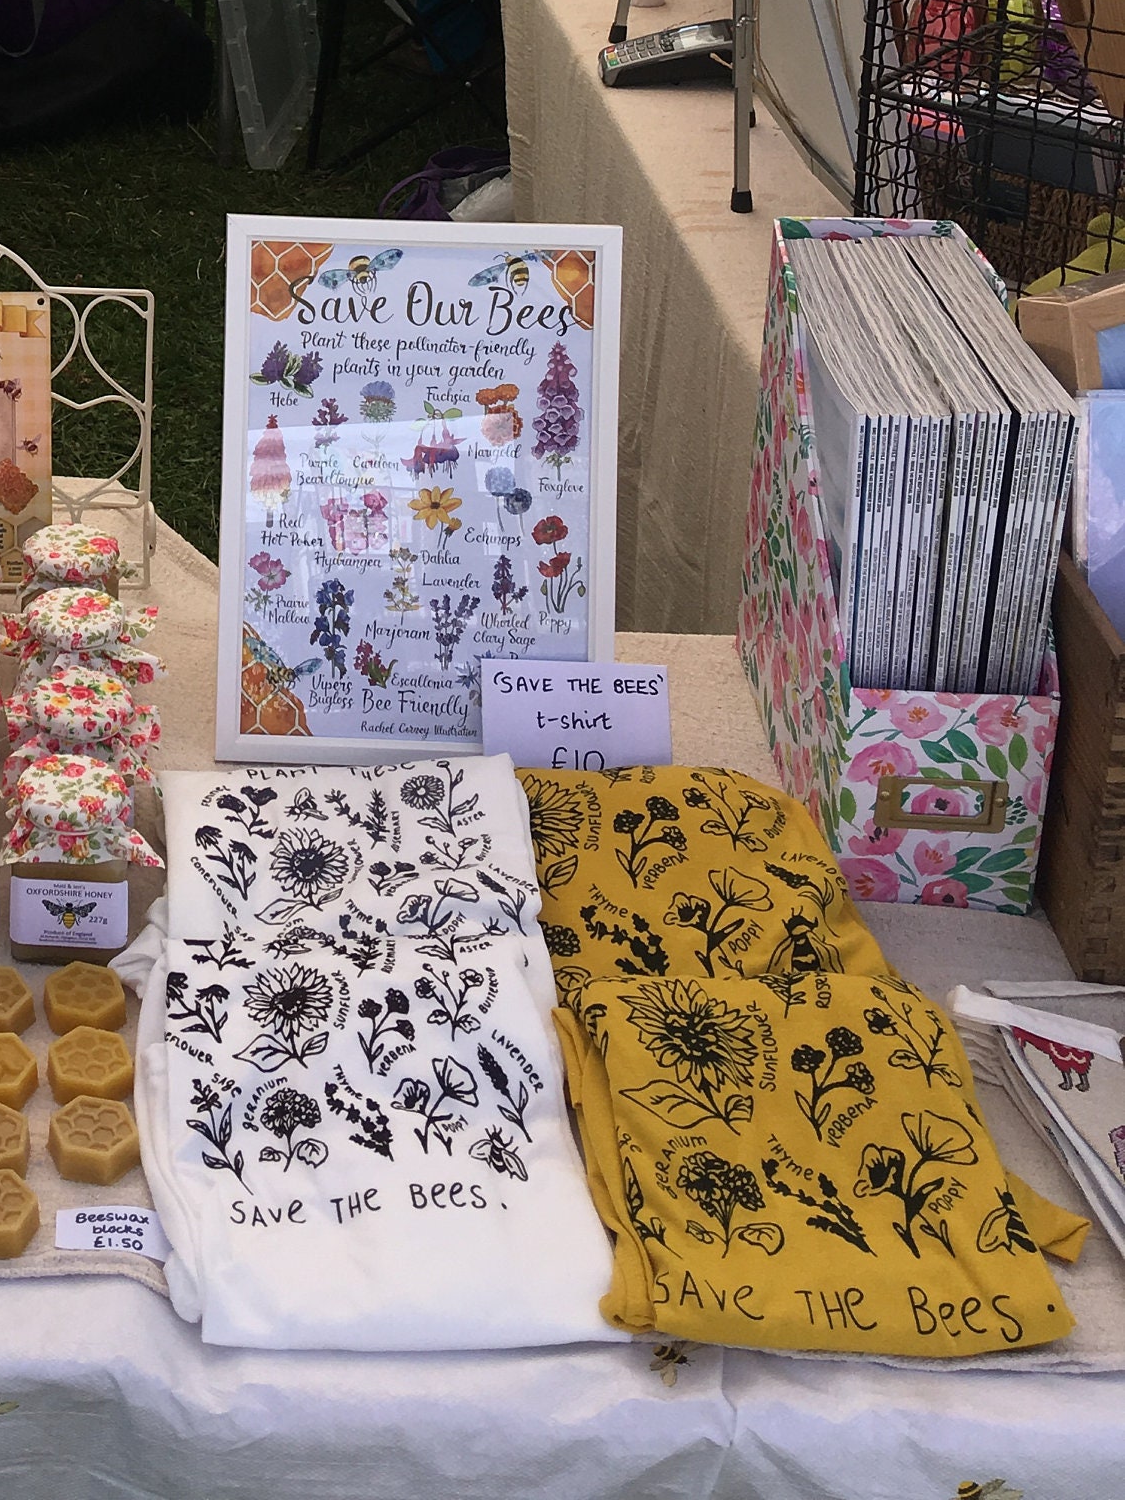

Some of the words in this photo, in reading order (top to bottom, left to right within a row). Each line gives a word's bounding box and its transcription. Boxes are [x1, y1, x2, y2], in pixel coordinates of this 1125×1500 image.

[288, 275, 395, 325] Save
[407, 280, 479, 326] Our
[486, 286, 583, 336] Bees
[301, 331, 347, 349] Plant
[351, 332, 391, 351] these
[396, 336, 536, 365] pollinator-friendly
[333, 358, 381, 383] plants
[388, 361, 402, 376] in
[405, 364, 444, 387] your
[449, 361, 506, 386] garden
[270, 392, 298, 407] Hebe
[426, 386, 471, 403] Fuchsia
[468, 444, 522, 459] Marigold
[300, 453, 338, 471] Purple
[296, 470, 374, 488] Beardtongue
[538, 478, 585, 499] Foxglove
[279, 514, 304, 528] Red
[261, 530, 287, 546] Hot
[290, 531, 324, 546] Poker
[464, 527, 521, 547] Echinops
[315, 551, 383, 574] Hydrangea
[420, 550, 461, 565] Dahlia
[422, 573, 481, 590] Lavender
[276, 596, 310, 609] Prairie
[268, 609, 310, 624] Mallow
[481, 612, 530, 629] Whorled
[539, 612, 572, 634] Poppy
[365, 620, 430, 649] Marjoram
[473, 631, 506, 652] Clary
[508, 628, 536, 650] Sage
[391, 672, 454, 689] Escallonia
[567, 678, 602, 693] THE
[309, 690, 353, 713] Bugloss
[362, 689, 392, 713] Bee
[398, 690, 469, 727] Friendly
[361, 721, 394, 734] Rachel
[537, 710, 612, 730] t-shirt
[552, 747, 605, 771] £10
[456, 810, 486, 827] ASTER
[26, 888, 82, 897] OXFORDSHIRE
[85, 891, 113, 899] HONEY
[588, 883, 629, 918] THYME
[88, 916, 108, 924] 227g
[344, 898, 374, 926] THYME
[442, 911, 468, 935] POPPY
[728, 919, 765, 955] POPPY
[459, 942, 493, 954] ASTER
[330, 969, 351, 1030] SUNFLOWER
[748, 1000, 777, 1092] SUNFLOWER
[377, 1043, 416, 1077] VERBENA
[211, 1072, 243, 1098] SAGE
[332, 1064, 364, 1100] THYME
[443, 1115, 468, 1132] POPPY
[826, 1096, 879, 1149] VERBENA
[766, 1134, 814, 1182] THYME
[929, 1176, 969, 1216] POPPY
[230, 1199, 307, 1228] SAVE
[331, 1187, 382, 1223] THE
[75, 1212, 150, 1224] Beeswax
[92, 1224, 144, 1237] blocks
[94, 1236, 144, 1250] £1.50
[653, 1270, 765, 1322] SAVE
[794, 1287, 877, 1332] THE
